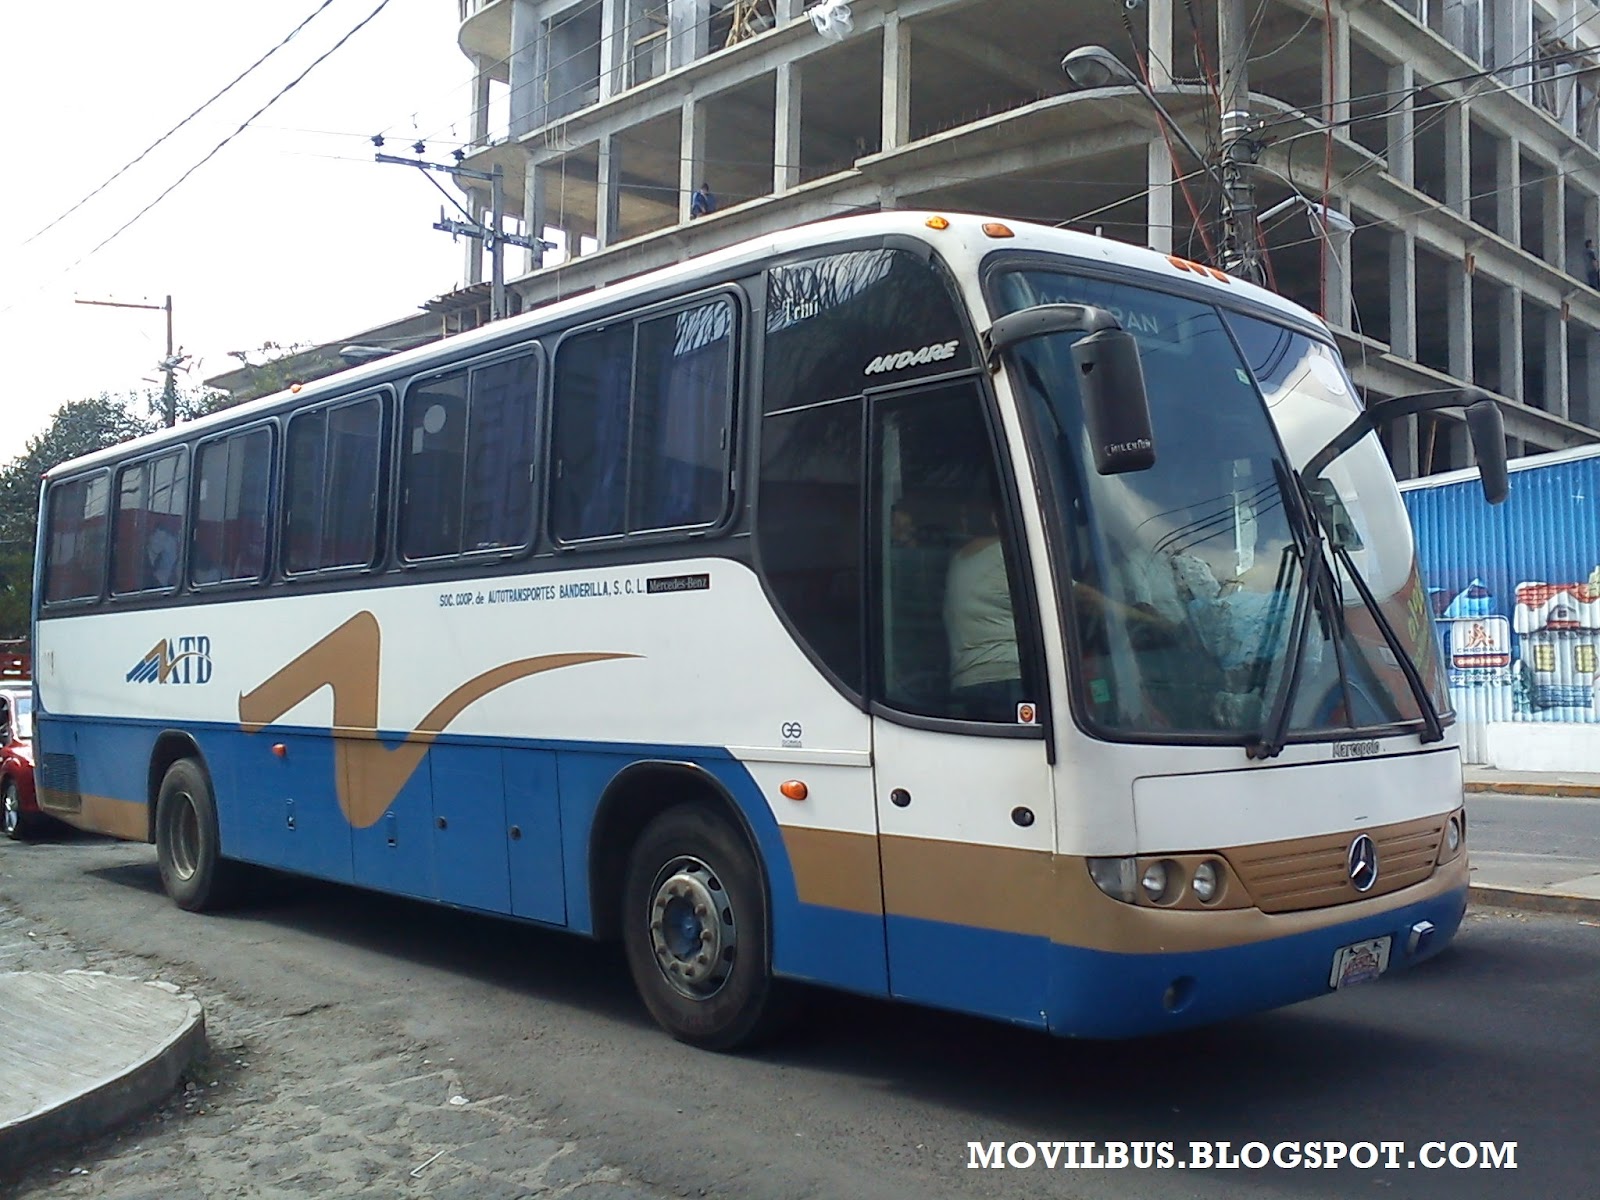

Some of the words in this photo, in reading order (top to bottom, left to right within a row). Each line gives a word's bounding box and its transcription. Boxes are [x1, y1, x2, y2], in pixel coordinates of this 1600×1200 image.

[864, 340, 959, 375] ANDARE
[475, 591, 484, 604] de
[488, 585, 556, 604] AUTOTRANSPORTES
[559, 581, 612, 599] BANDERILLA,
[649, 575, 708, 592] Mercedes-Benz
[1332, 741, 1380, 758] Marcopolo
